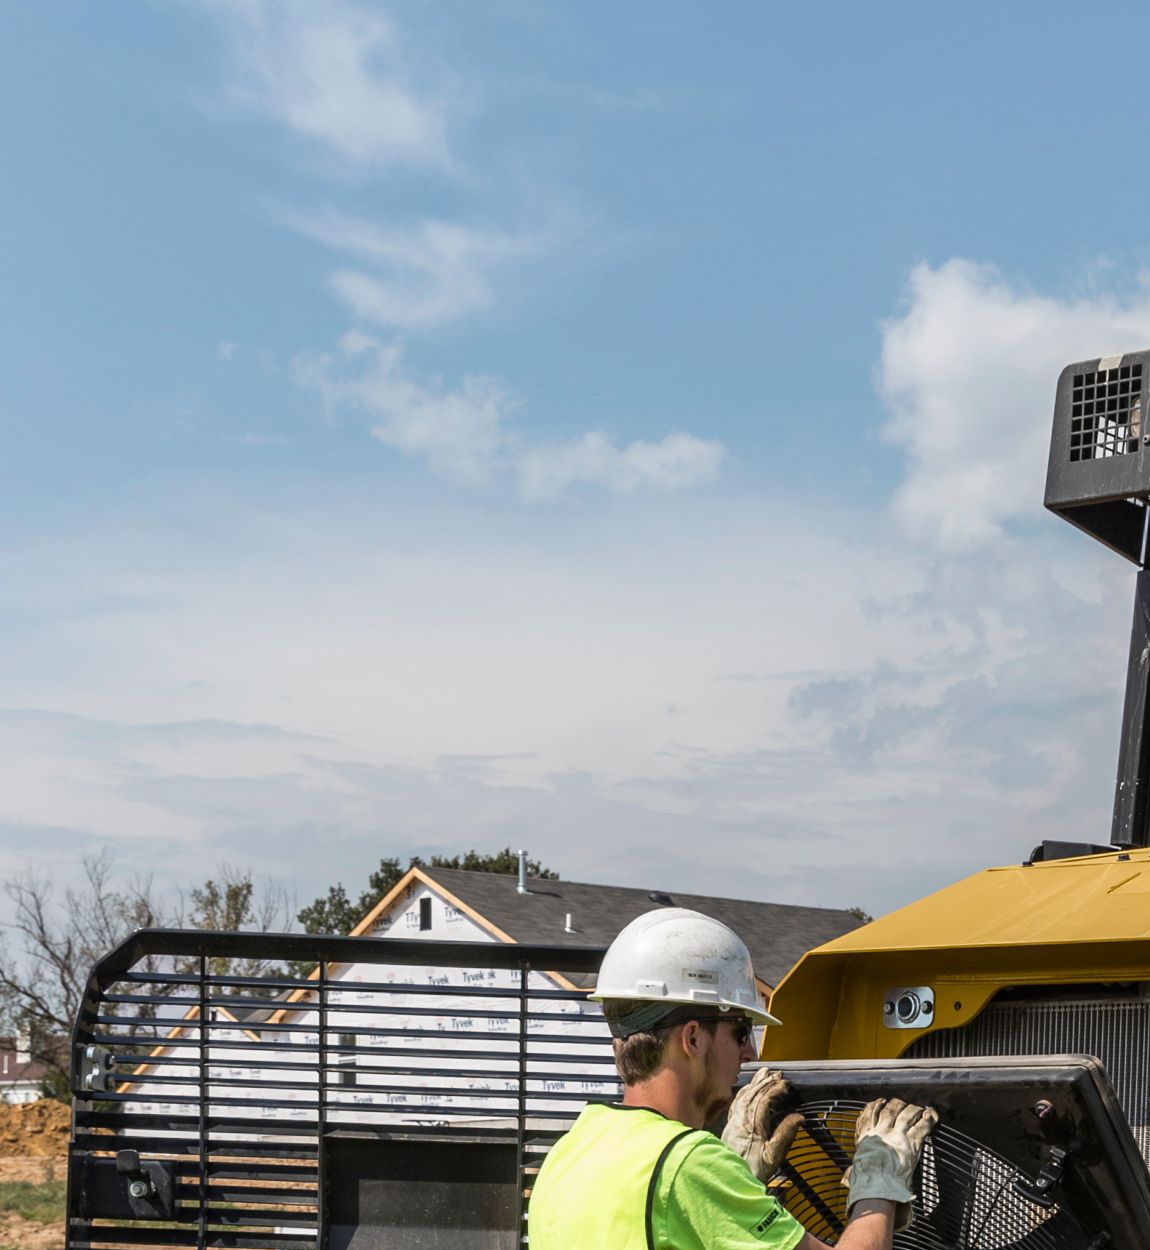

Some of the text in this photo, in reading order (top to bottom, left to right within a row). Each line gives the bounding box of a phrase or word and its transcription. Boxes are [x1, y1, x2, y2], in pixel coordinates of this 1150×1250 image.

[463, 971, 485, 984] Tyvek
[451, 1018, 474, 1030] Tyvek
[542, 1080, 566, 1092] Tyvek
